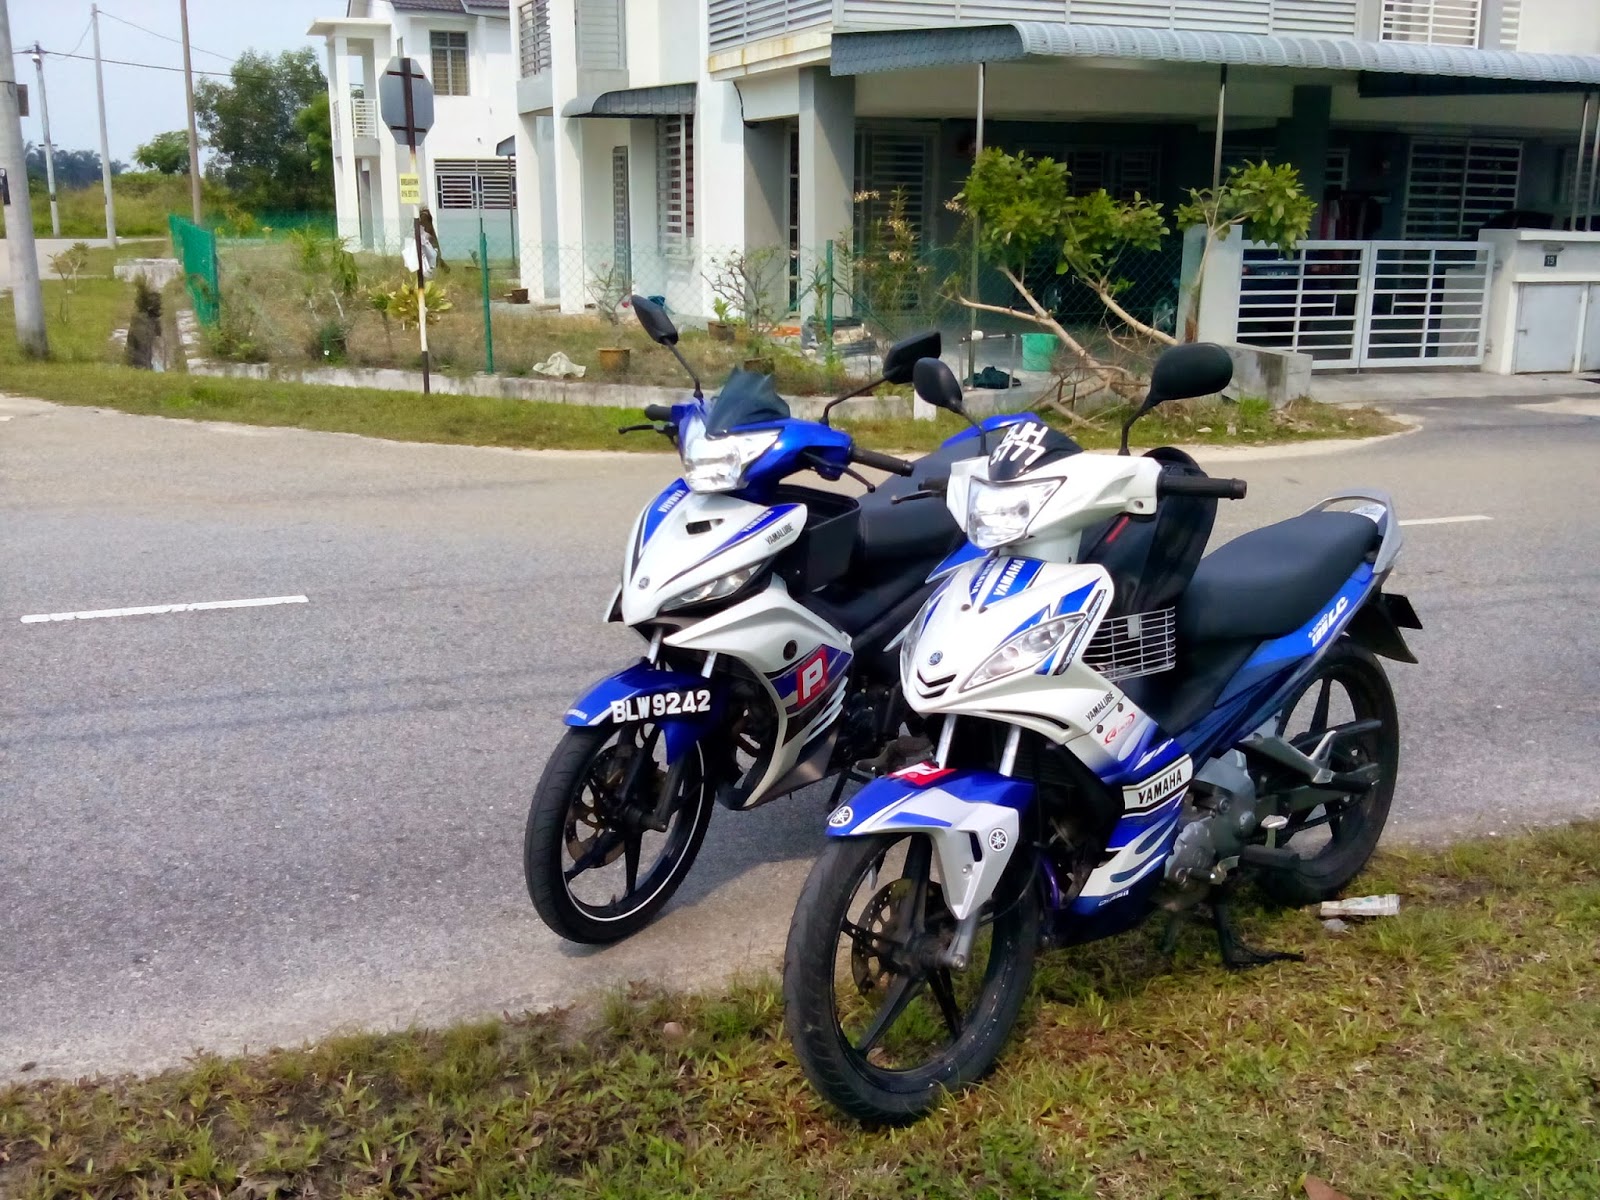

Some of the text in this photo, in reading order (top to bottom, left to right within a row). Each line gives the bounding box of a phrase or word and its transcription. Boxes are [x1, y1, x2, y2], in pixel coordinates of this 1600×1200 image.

[1002, 421, 1049, 446] BJH
[764, 522, 794, 545] YAMALUBE
[992, 559, 1026, 596] YAMAHA
[802, 657, 824, 700] P
[610, 689, 711, 724] BLW9242
[1085, 690, 1116, 722] YAMALUBE
[1138, 768, 1183, 804] YAMAHA
